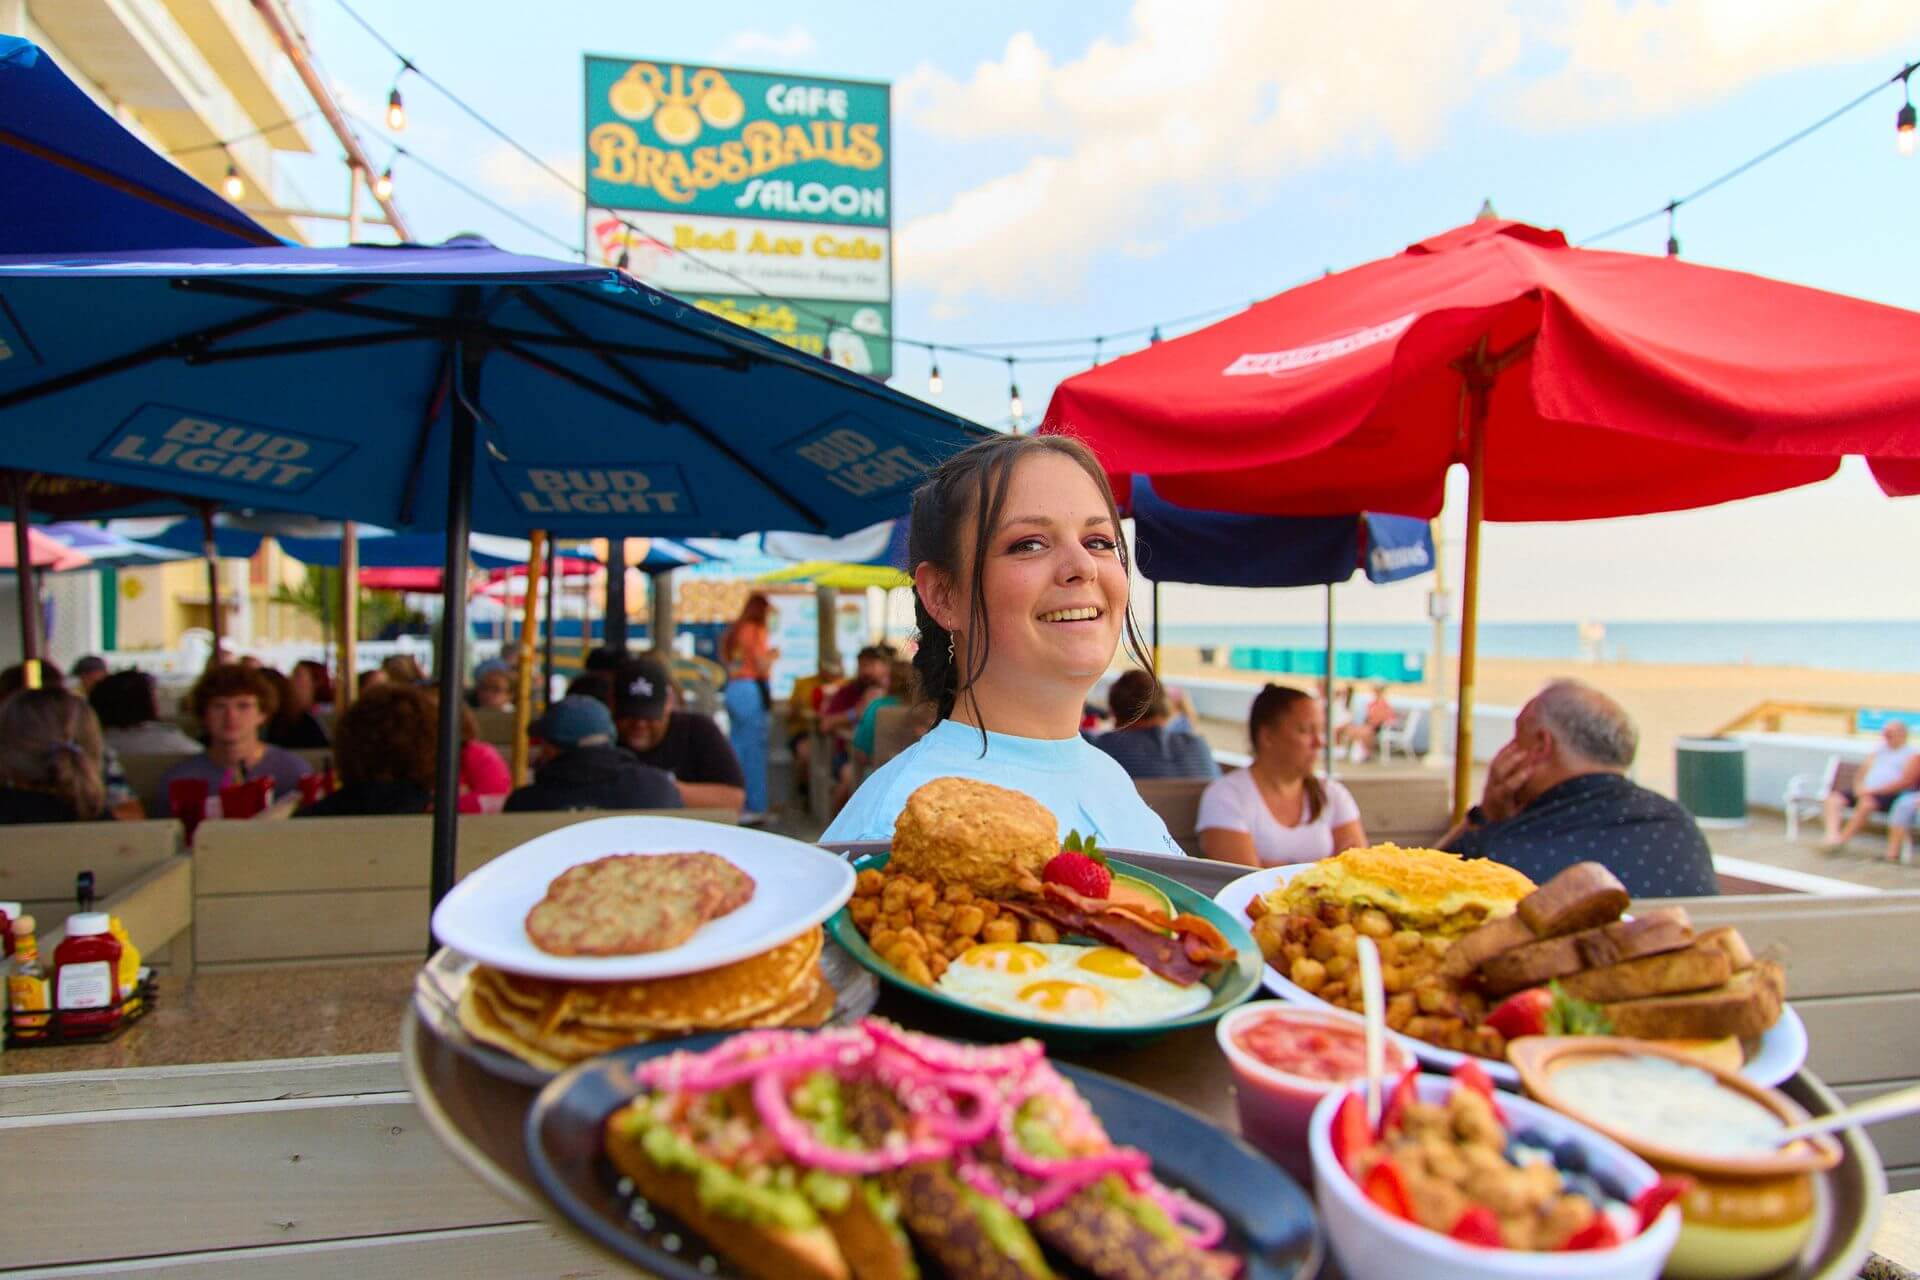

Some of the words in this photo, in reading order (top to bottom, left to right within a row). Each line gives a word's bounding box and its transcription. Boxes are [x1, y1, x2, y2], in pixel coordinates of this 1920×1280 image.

[766, 84, 848, 119] CAFE
[735, 179, 885, 218] SALOON
[813, 234, 881, 261] Cafe
[163, 417, 309, 461] BUD
[797, 428, 878, 472] BUD
[110, 435, 314, 486] LIGHT
[827, 446, 931, 497] LIGHT
[527, 469, 651, 493] BUD
[519, 492, 679, 513] LIGHT
